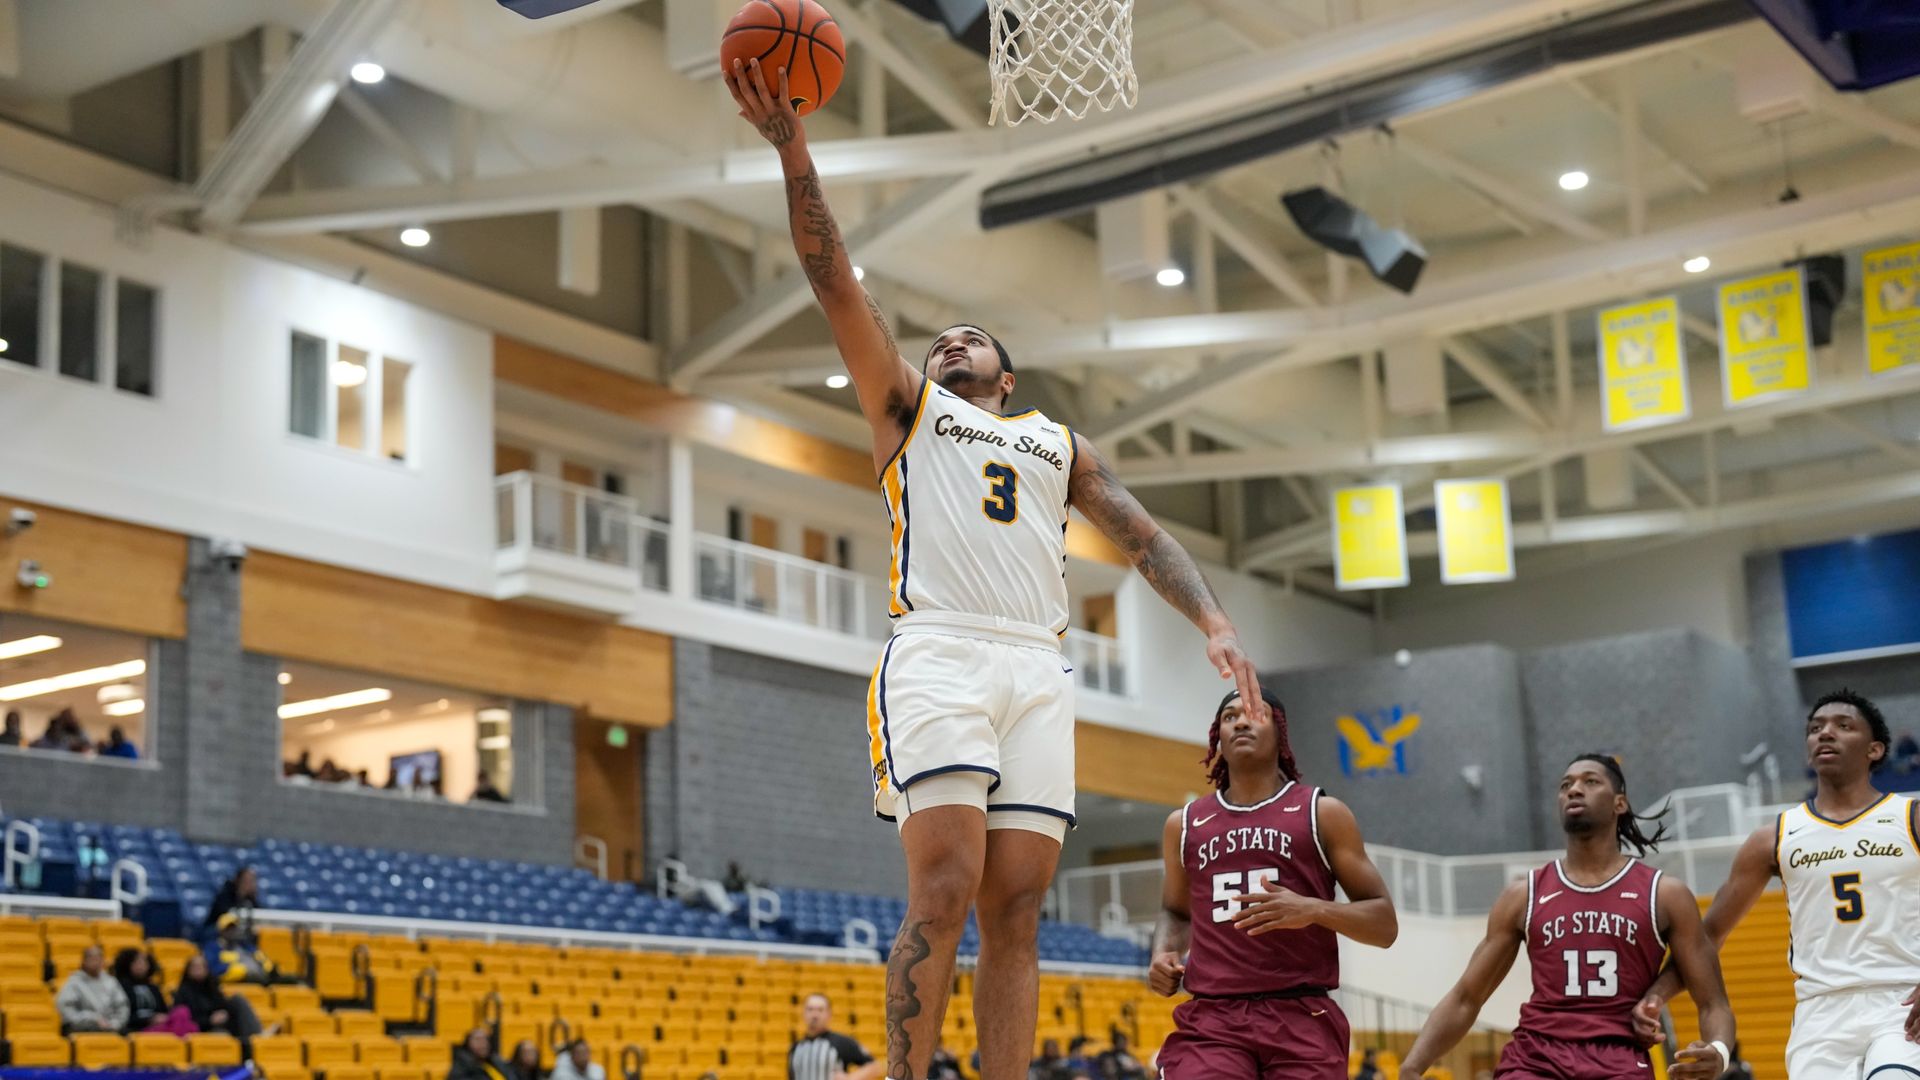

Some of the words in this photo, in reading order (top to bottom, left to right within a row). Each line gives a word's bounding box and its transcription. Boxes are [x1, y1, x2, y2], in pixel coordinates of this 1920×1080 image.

[934, 414, 1007, 447] Coppin
[1014, 435, 1063, 471] State
[982, 460, 1019, 525] 3
[1198, 836, 1220, 870] SC
[1226, 827, 1292, 859] STATE
[1790, 846, 1847, 868] Coppin
[1853, 839, 1904, 858] State
[1830, 870, 1865, 924] 5
[1542, 915, 1565, 947] SC
[1572, 910, 1638, 945] STATE
[1563, 949, 1618, 997] 13
